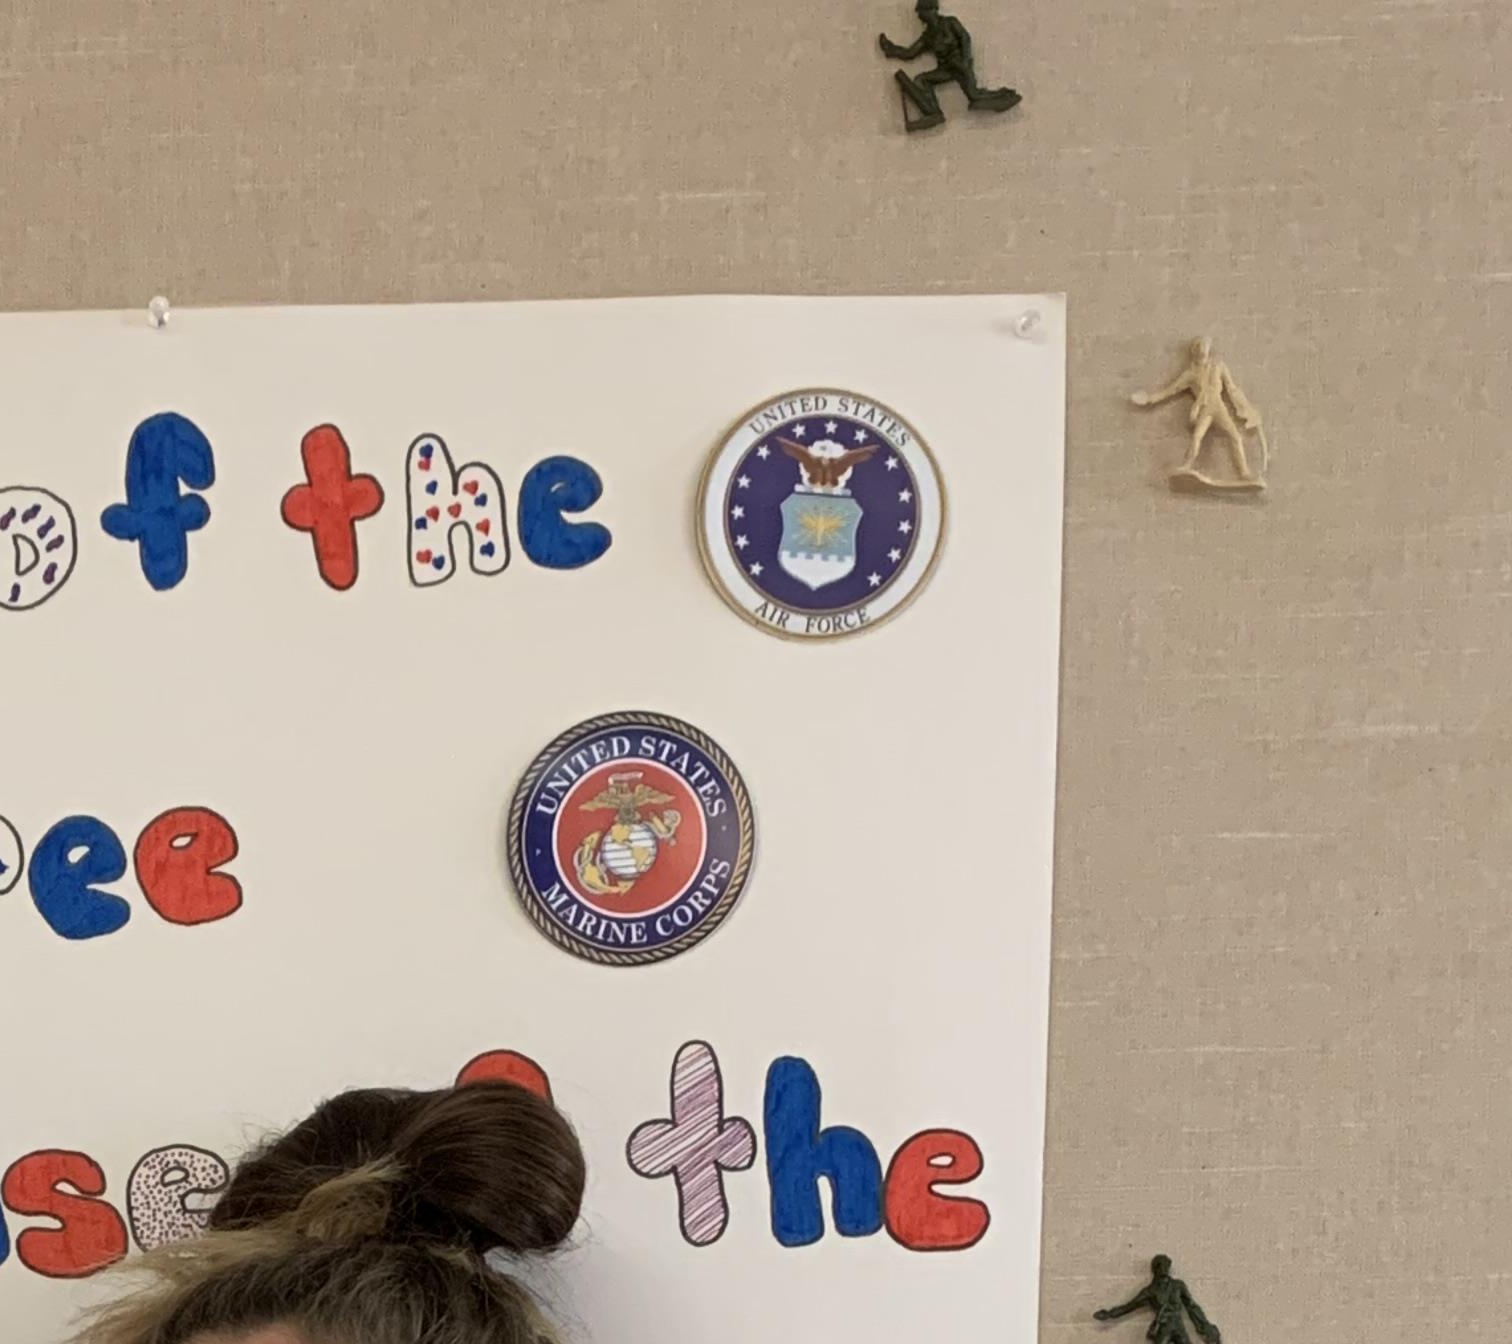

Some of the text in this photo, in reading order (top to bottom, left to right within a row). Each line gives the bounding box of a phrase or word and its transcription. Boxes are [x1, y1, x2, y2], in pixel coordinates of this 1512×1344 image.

[750, 396, 912, 448] UNITED STATES
[280, 424, 613, 591] the
[754, 601, 872, 634] AIR FORCE
[536, 735, 727, 818] UNITED STATES
[541, 858, 731, 945] MARINE CORPS
[626, 1040, 992, 1252] the
